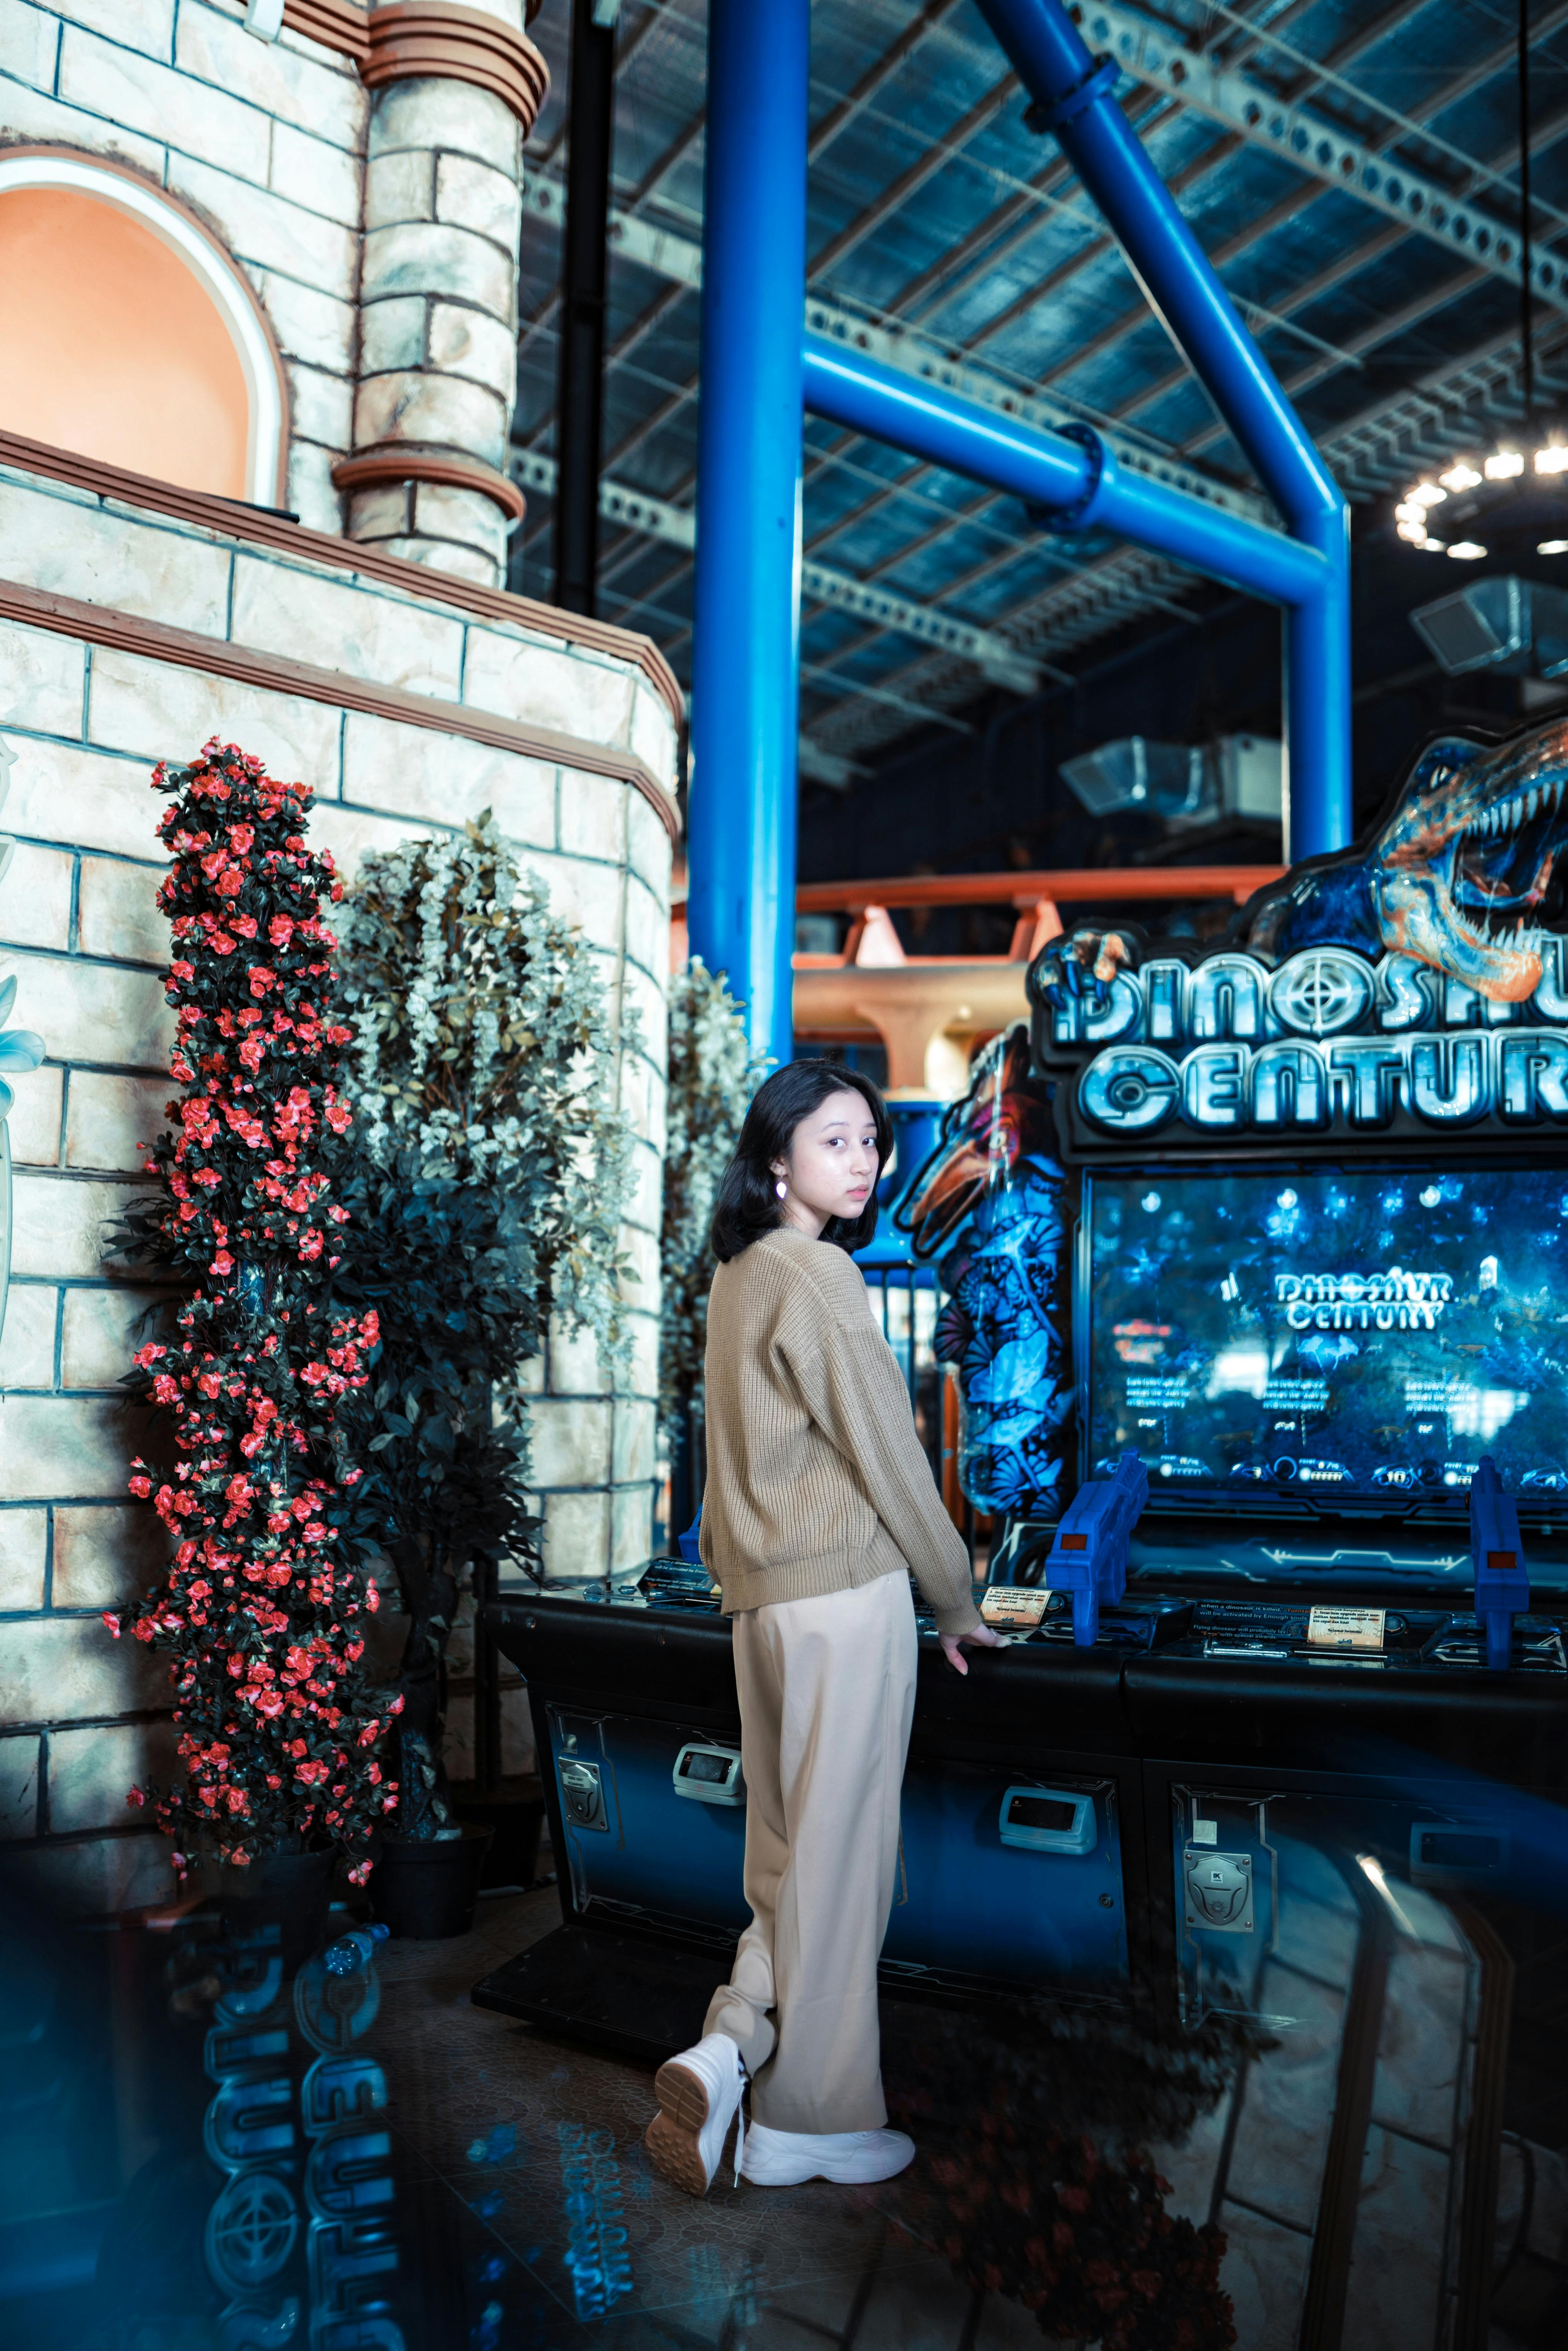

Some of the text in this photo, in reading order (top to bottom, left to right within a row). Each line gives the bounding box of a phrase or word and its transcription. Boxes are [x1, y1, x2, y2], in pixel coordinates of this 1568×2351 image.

[1081, 1031, 1568, 1131] CENTUR
[1275, 1267, 1453, 1302] DINOSAUR
[1286, 1299, 1444, 1329] CENTURY
